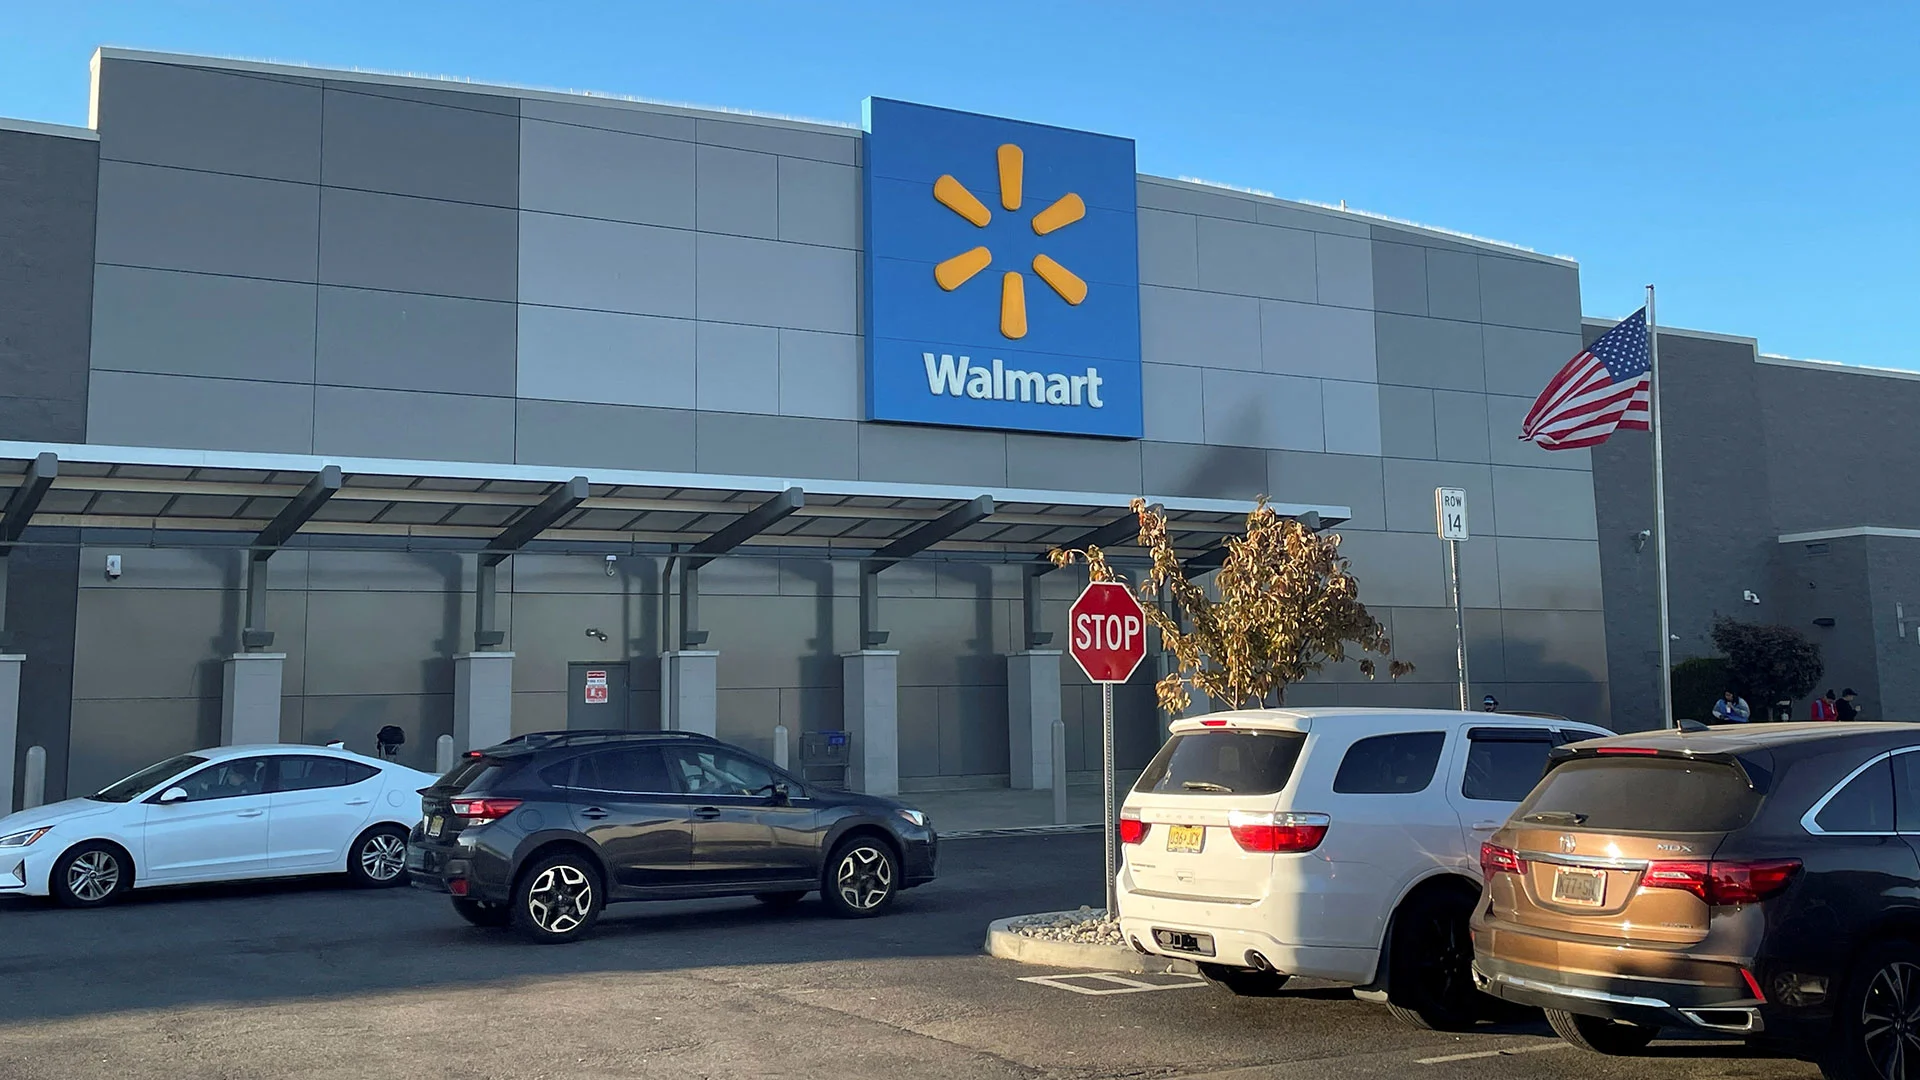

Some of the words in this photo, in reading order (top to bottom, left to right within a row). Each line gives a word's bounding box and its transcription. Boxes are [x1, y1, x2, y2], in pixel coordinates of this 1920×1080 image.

[923, 353, 1103, 408] Walmart
[1444, 495, 1462, 507] ROW
[1447, 513, 1462, 532] 14
[1075, 613, 1140, 651] STOP
[1657, 844, 1693, 853] MDX
